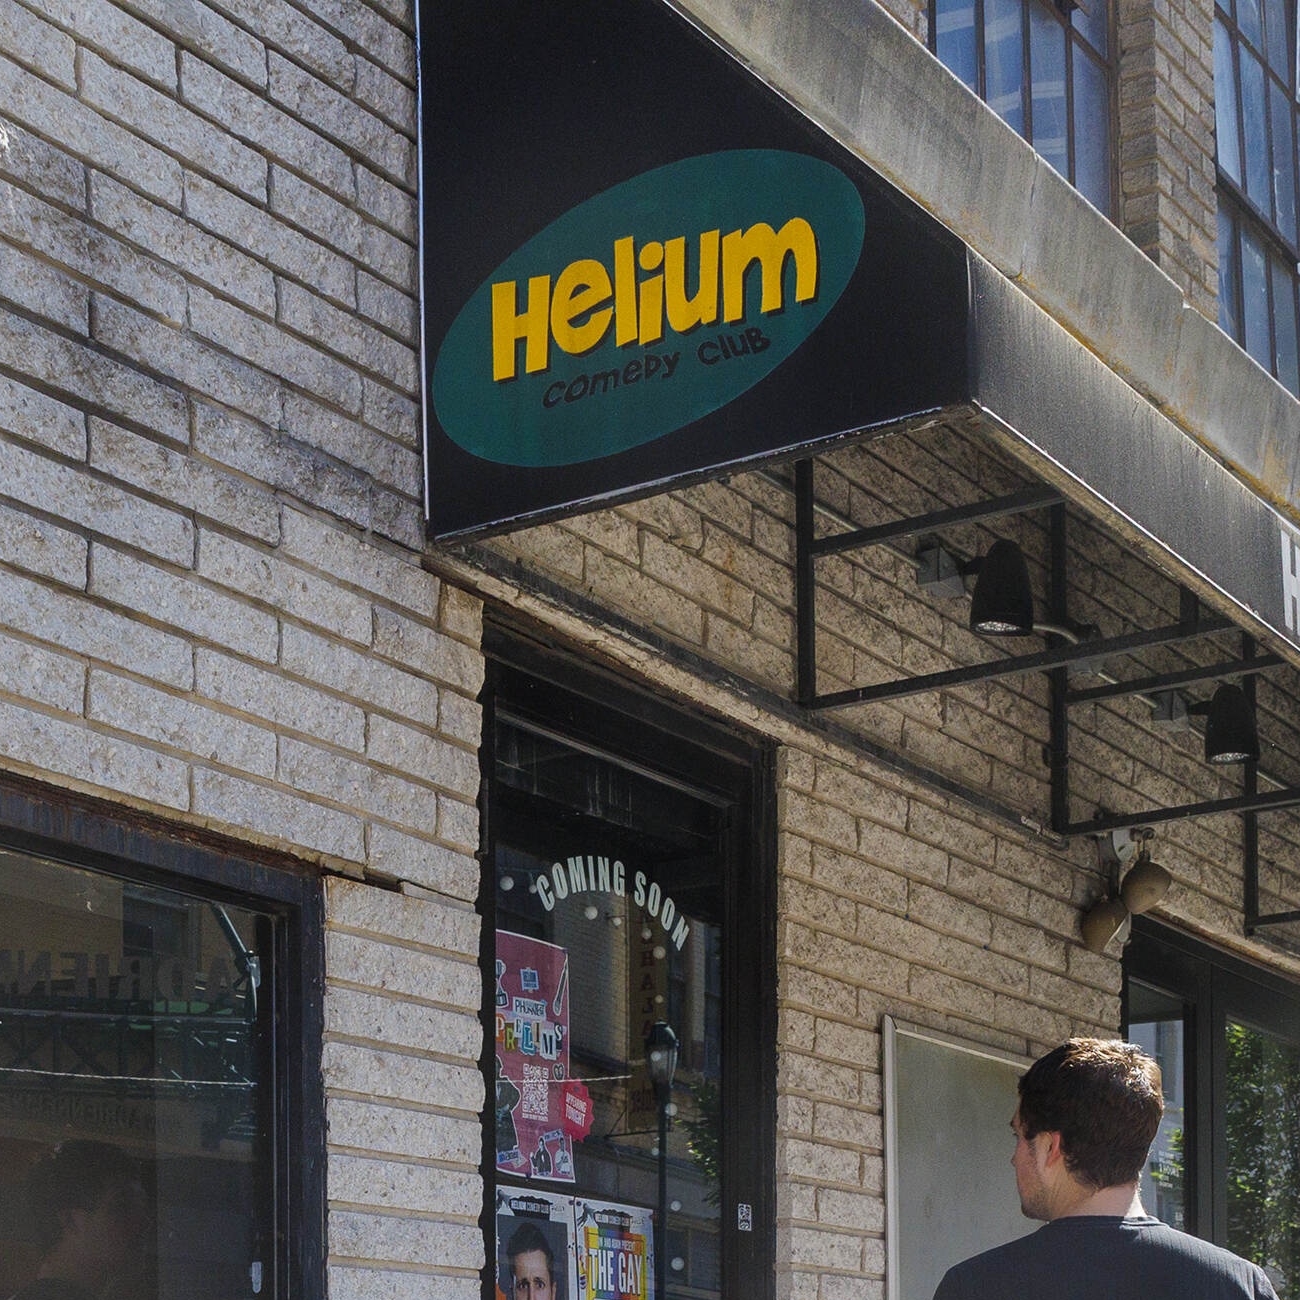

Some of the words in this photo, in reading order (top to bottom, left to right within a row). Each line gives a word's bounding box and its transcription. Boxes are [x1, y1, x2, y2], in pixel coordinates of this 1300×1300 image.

[491, 216, 818, 383] Helium
[536, 856, 625, 911] COMING
[634, 871, 690, 951] SOON
[588, 1248, 615, 1291] THE
[618, 1251, 642, 1295] GAY
